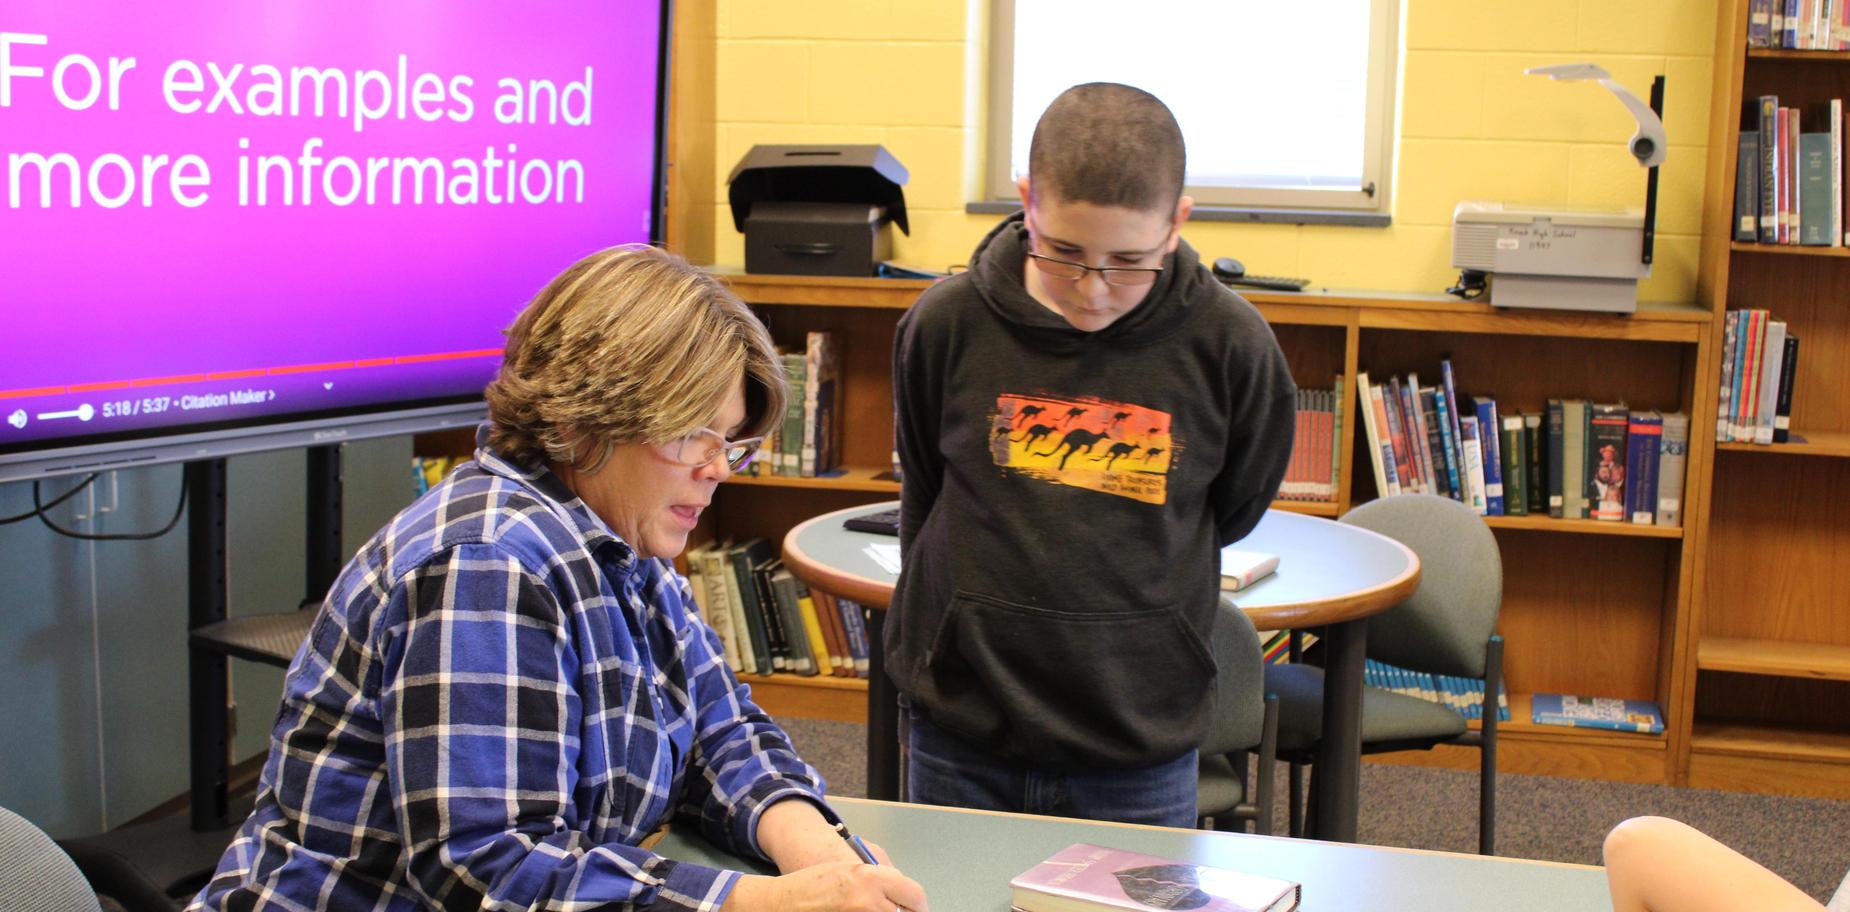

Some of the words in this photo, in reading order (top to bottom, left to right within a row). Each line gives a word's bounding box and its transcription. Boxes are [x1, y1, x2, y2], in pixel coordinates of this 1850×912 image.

[0, 31, 137, 112] For
[162, 53, 475, 132] examples
[494, 66, 593, 126] and
[8, 152, 211, 209] more
[238, 137, 585, 207] information
[102, 400, 132, 418] 5:18
[142, 396, 171, 414] 5:37
[180, 393, 229, 411] Citation
[229, 388, 267, 406] Maker
